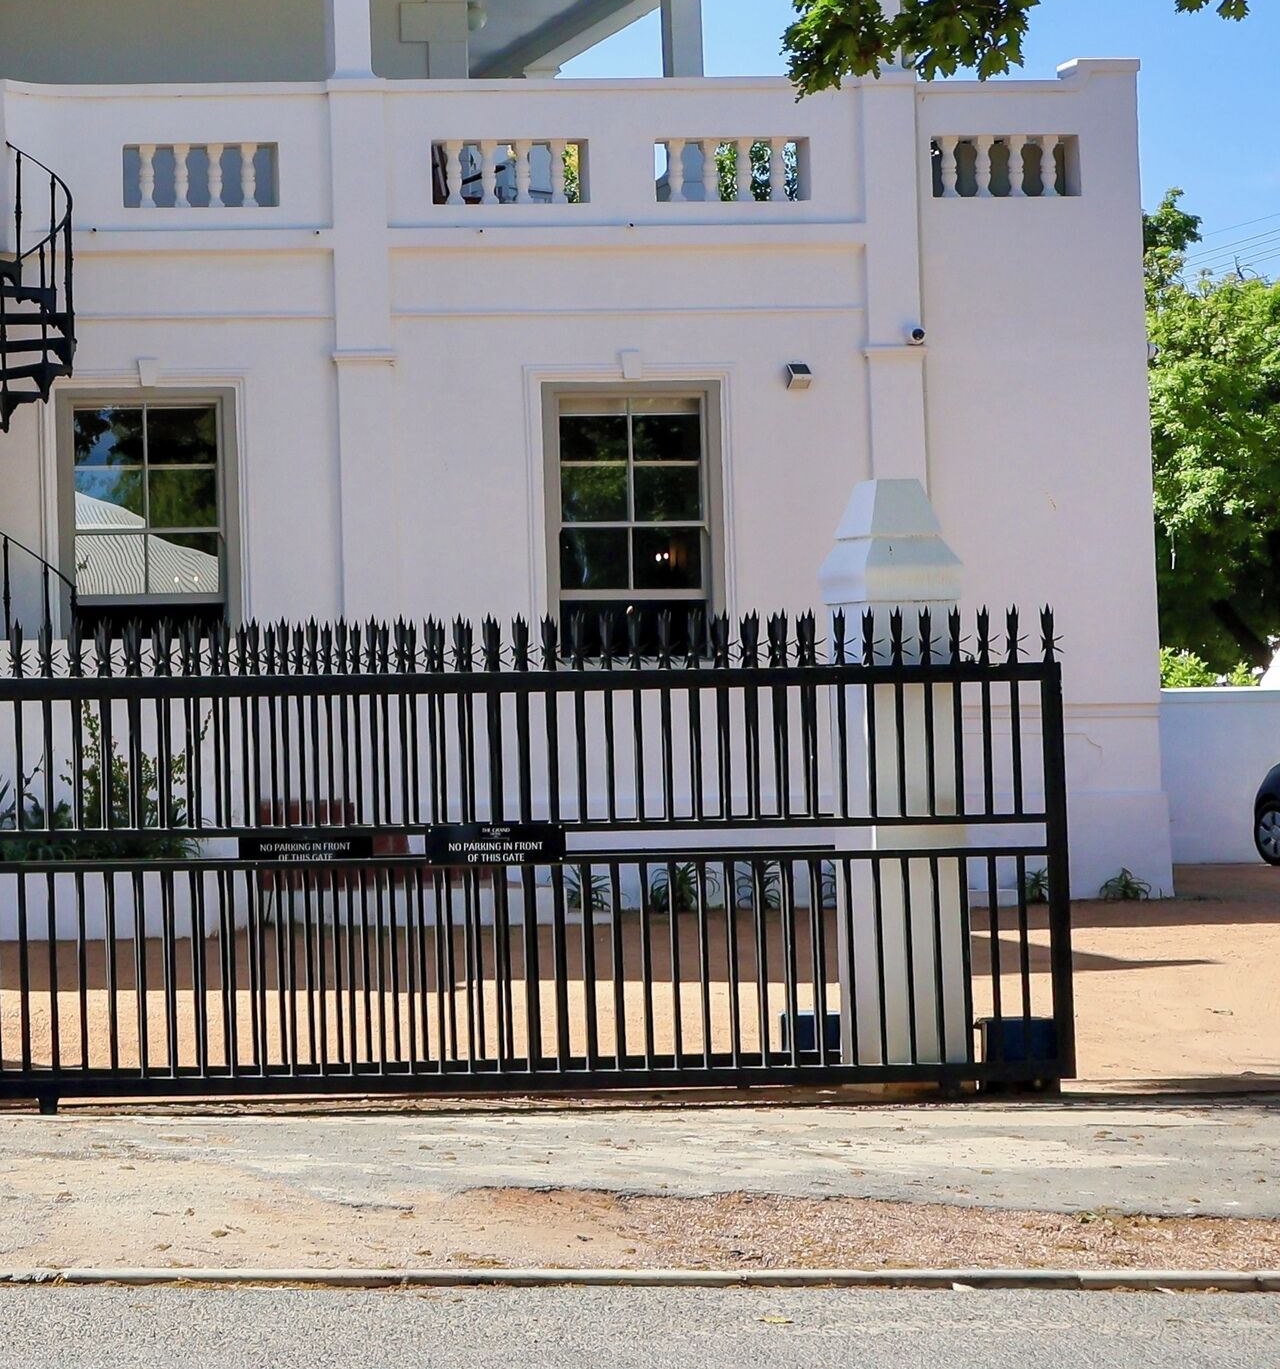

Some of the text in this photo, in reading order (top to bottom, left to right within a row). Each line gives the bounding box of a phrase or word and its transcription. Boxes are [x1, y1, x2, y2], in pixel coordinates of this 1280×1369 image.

[260, 841, 351, 852] NO PARKING IN FRONT
[448, 841, 543, 852] NO PARKING IN FRONT
[278, 853, 333, 861] OF THIS GATE
[467, 852, 525, 863] OF THIS GATE
